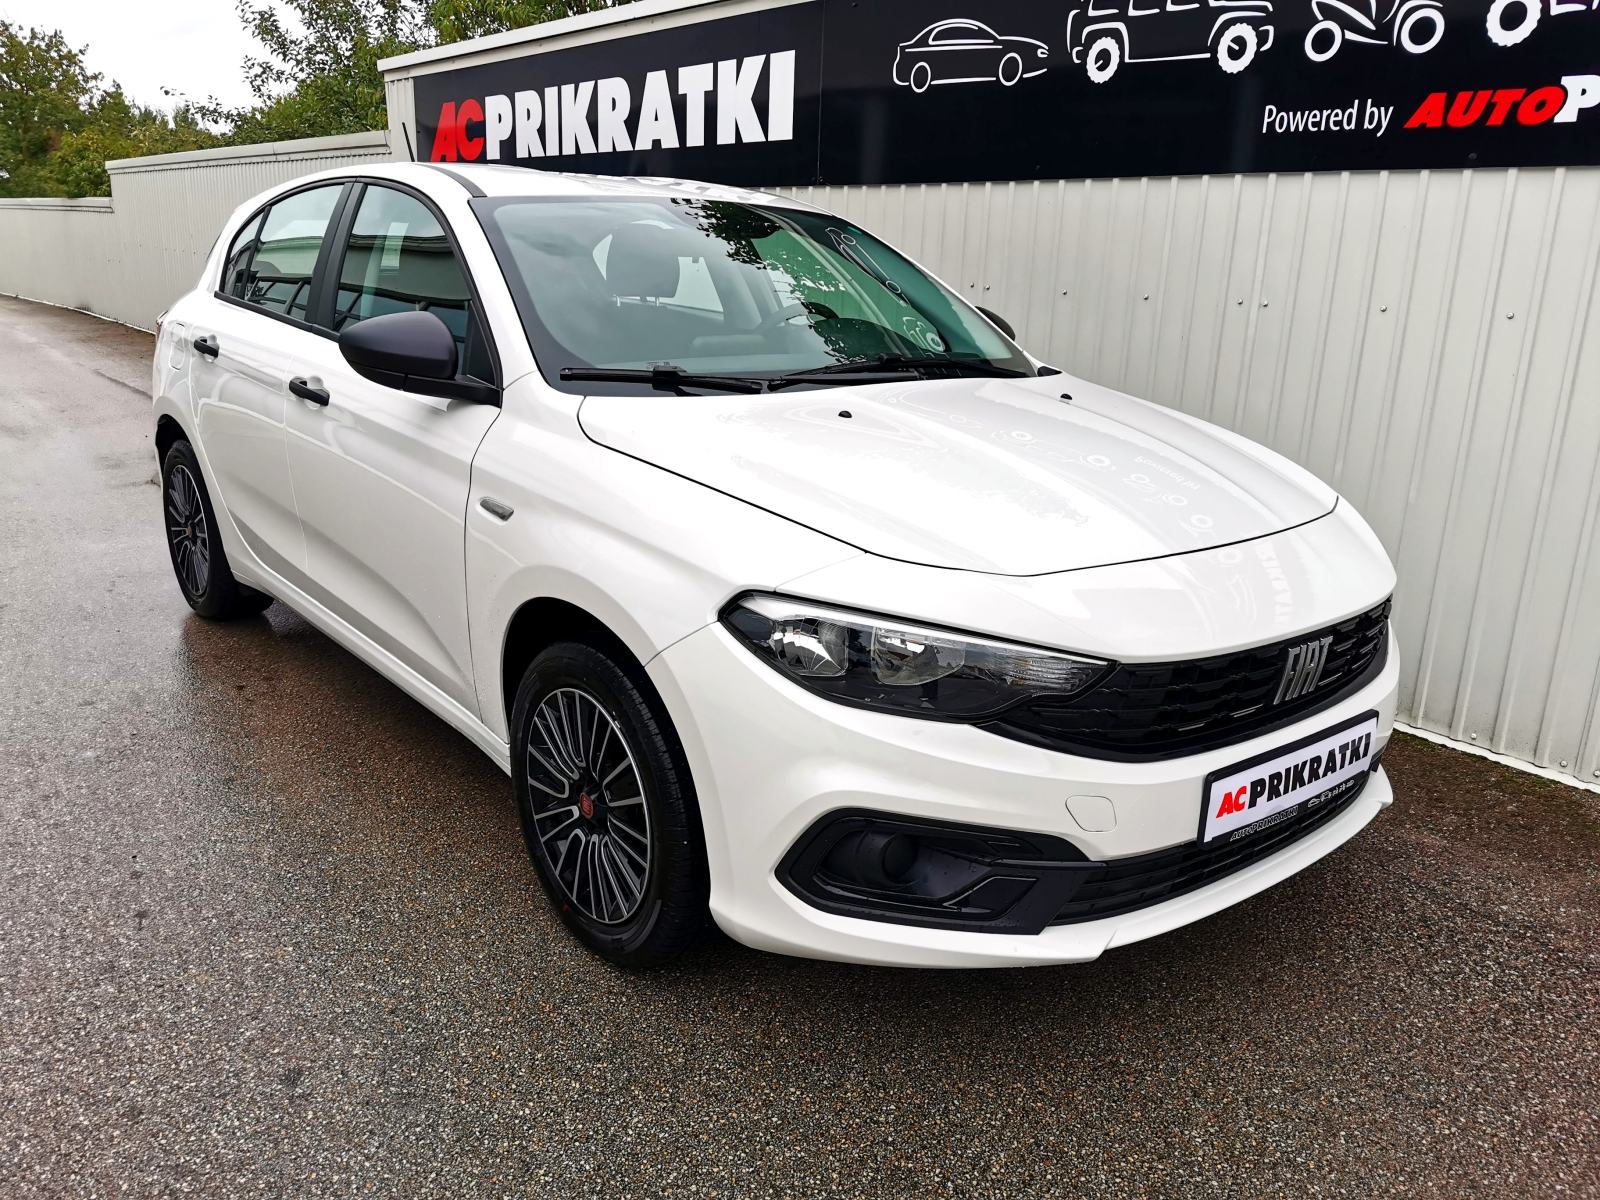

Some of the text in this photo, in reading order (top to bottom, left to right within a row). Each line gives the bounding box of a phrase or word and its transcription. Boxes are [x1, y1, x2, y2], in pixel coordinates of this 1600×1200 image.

[430, 49, 796, 163] ACPRIKRATKI
[1262, 99, 1358, 133] Powered
[1364, 98, 1394, 138] by
[1273, 635, 1334, 705] FIAT
[1215, 731, 1372, 819] ACPRIKRATKI
